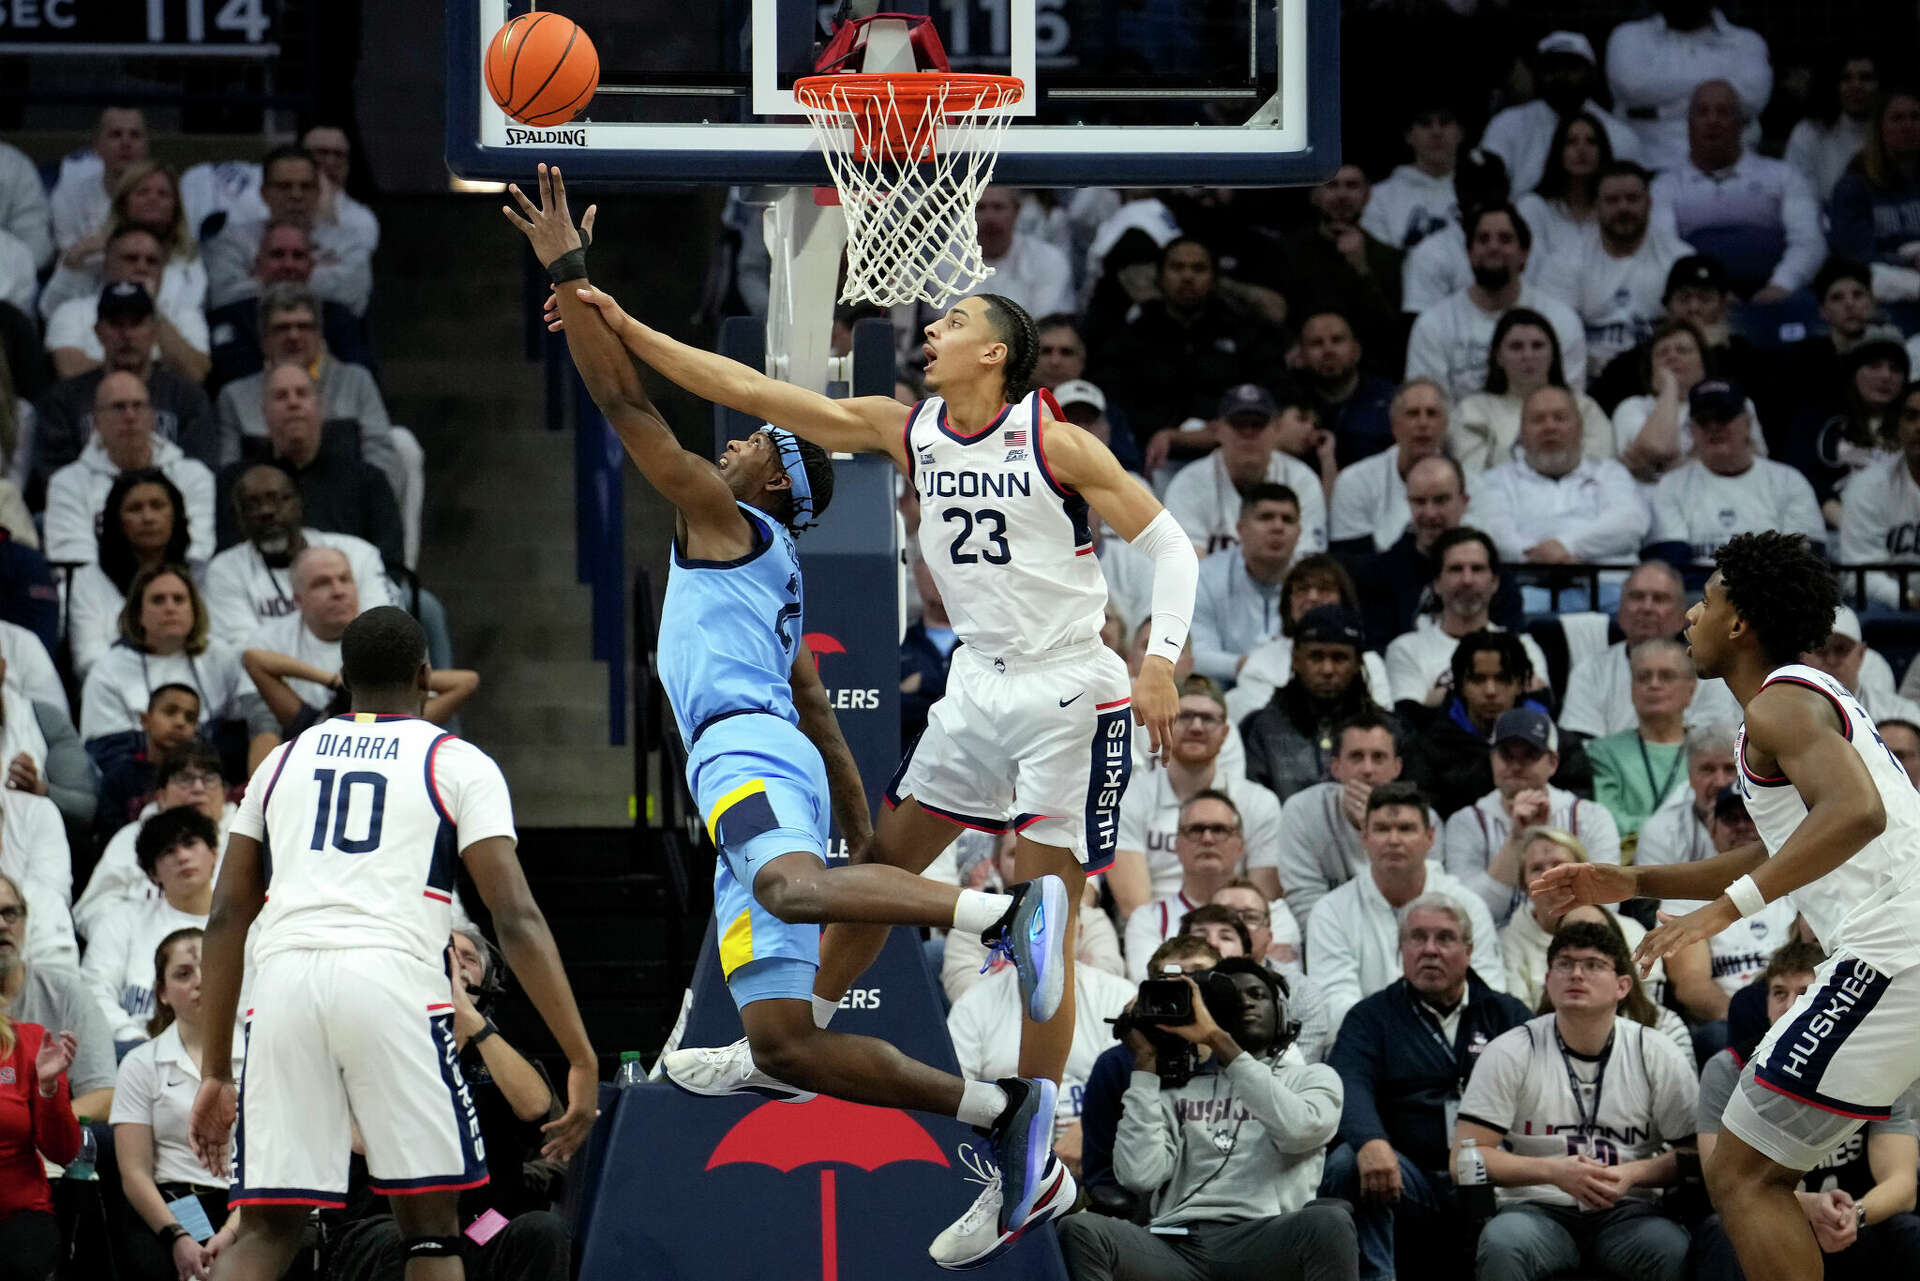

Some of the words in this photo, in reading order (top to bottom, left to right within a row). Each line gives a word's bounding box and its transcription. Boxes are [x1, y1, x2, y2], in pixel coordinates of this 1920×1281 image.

[505, 128, 586, 147] SPALDING
[923, 471, 1031, 498] UCONN
[942, 507, 1012, 565] 23
[316, 734, 399, 760] DIARRA
[310, 768, 388, 854] 10
[1096, 719, 1126, 850] HUSKIES
[1782, 960, 1877, 1079] HUSKIES
